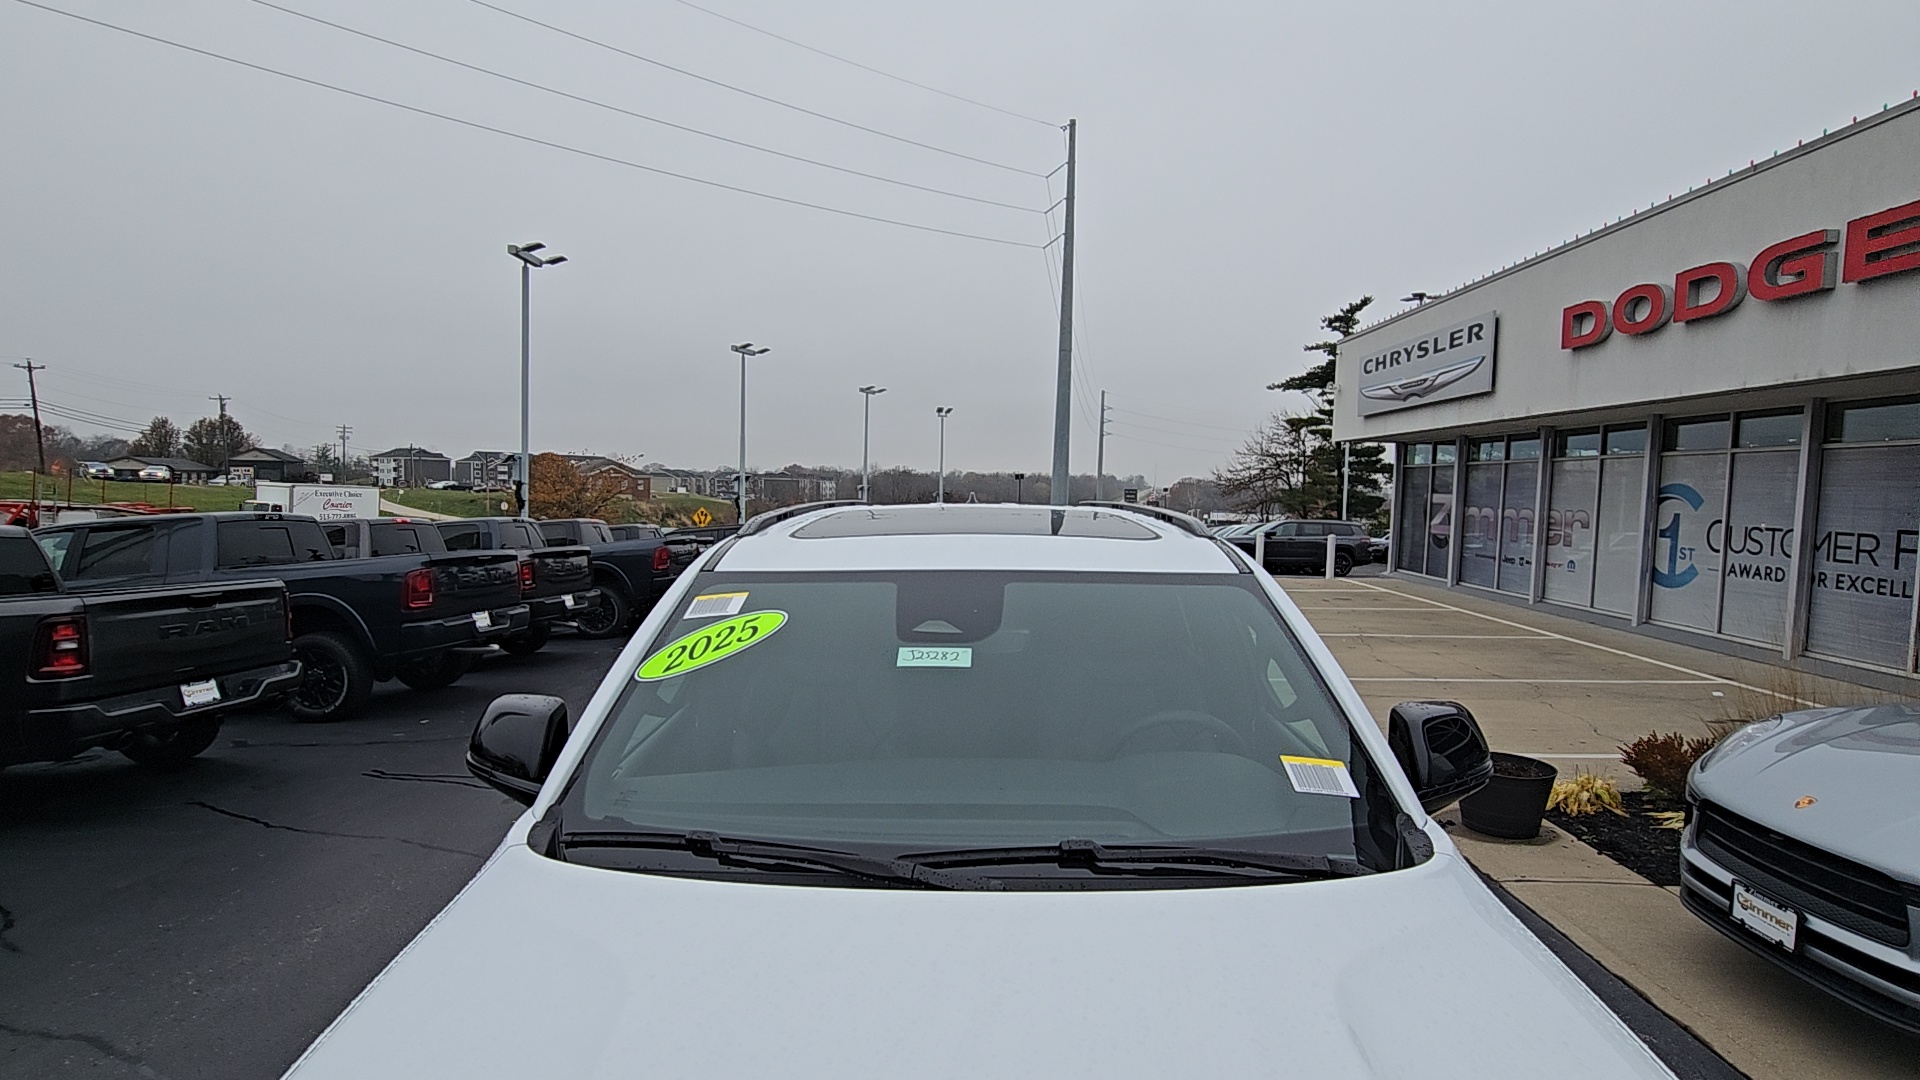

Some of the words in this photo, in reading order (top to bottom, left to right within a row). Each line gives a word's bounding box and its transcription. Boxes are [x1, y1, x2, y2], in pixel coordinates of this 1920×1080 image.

[1561, 199, 1920, 350] DODGE
[1363, 322, 1484, 374] CHRYSLER
[314, 490, 343, 498] Executive
[323, 498, 353, 510] Courier
[1431, 493, 1590, 549] Zmmer
[1727, 563, 1785, 583] AWARD
[159, 614, 250, 640] RAM
[662, 616, 761, 674] 2025
